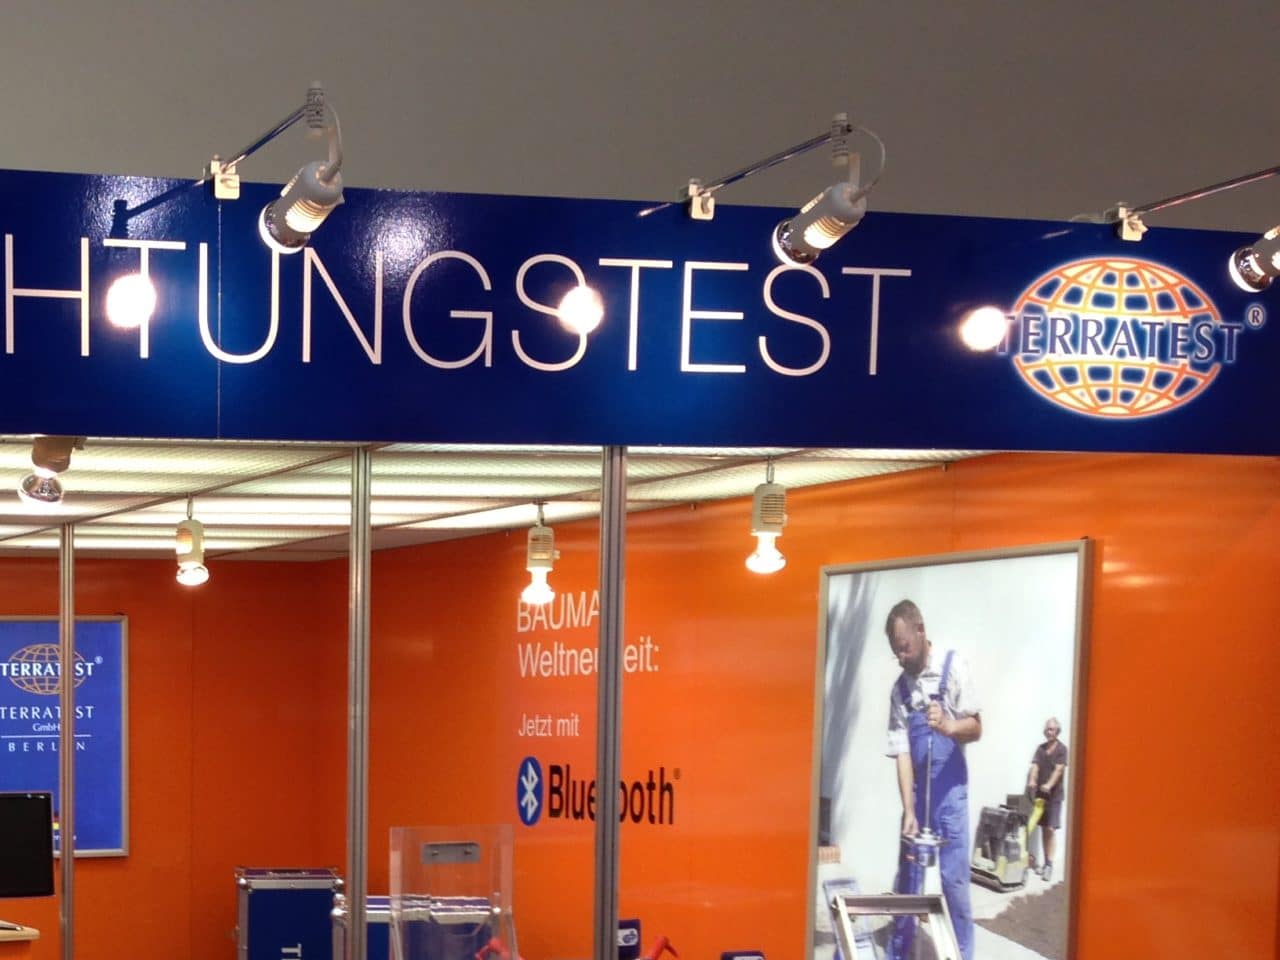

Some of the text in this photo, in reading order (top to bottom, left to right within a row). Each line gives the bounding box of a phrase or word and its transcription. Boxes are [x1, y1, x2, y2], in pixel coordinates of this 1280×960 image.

[517, 590, 601, 633] BAUMA
[517, 636, 660, 679] Weltneeit:
[0, 705, 95, 720] TERRATST
[518, 712, 580, 737] Jetzt mit
[32, 722, 61, 732] GmbH
[8, 741, 86, 752] BERLN
[548, 764, 674, 825] Blueooth
